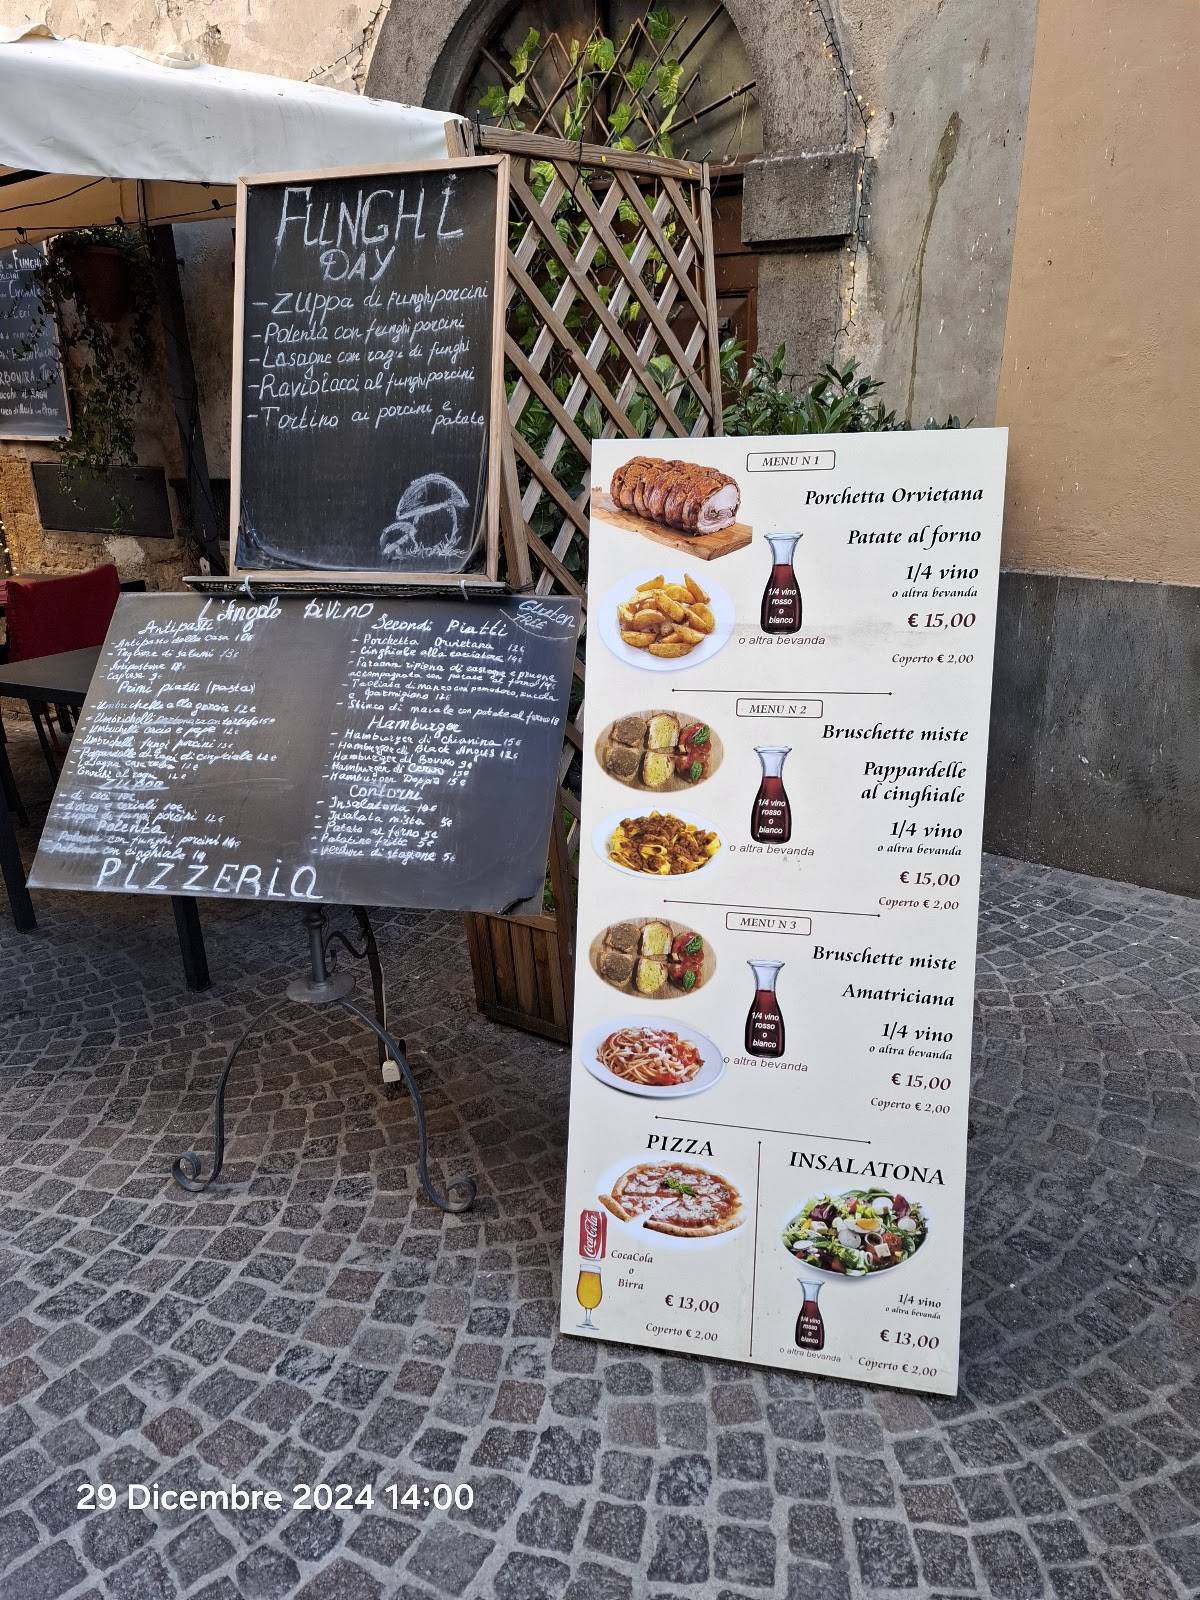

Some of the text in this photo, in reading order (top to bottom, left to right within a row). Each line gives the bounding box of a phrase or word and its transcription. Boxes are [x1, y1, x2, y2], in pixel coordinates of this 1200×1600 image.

[320, 246, 395, 281] DAY
[363, 285, 382, 307] di
[265, 323, 328, 343] Polenta
[334, 325, 362, 340] con
[337, 351, 360, 363] con
[409, 344, 422, 358] di
[428, 336, 470, 365] funghi
[364, 378, 382, 392] al
[261, 406, 338, 429] Tortino
[351, 407, 369, 422] ai
[375, 399, 432, 429] porcini
[431, 410, 484, 434] patate
[762, 455, 820, 467] MENU N 1
[804, 486, 983, 505] Porchetta Orvietana
[847, 525, 981, 550] Patate al forno
[905, 563, 978, 583] 1/4 vino
[768, 587, 797, 596] 1/4 vino
[901, 587, 928, 598] altra
[932, 586, 977, 597] bevanda
[769, 616, 793, 624] bianco
[907, 613, 976, 629] € 15,00
[738, 636, 826, 645] o altra bevanda
[891, 654, 974, 667] Coperto € 2,00
[749, 704, 807, 714] MENU N 2
[822, 723, 969, 742] Bruschette miste
[863, 761, 966, 783] Pappardelle
[758, 799, 769, 807] 1/4
[861, 783, 965, 808] al cinghiale
[759, 826, 783, 834] bianco
[889, 819, 963, 839] 1/4 vino
[739, 844, 763, 854] altra
[766, 844, 815, 856] bevanda
[887, 843, 914, 854] altra
[917, 844, 962, 856] bevanda
[899, 871, 960, 887] € 15,00
[878, 896, 959, 910] Coperto € 2,00
[740, 917, 797, 930] MENU N 3
[813, 945, 956, 970] Bruschette miste
[842, 984, 955, 1007] Amatriciana
[751, 1012, 779, 1021] 1/4 vino
[755, 1022, 775, 1030] rosso
[881, 1022, 953, 1043] 1/4 vino
[753, 1039, 777, 1048] bianco
[878, 1044, 904, 1056] altra
[908, 1046, 953, 1060] bevanda
[723, 1056, 808, 1072] o altra bevanda
[891, 1073, 951, 1091] € 15,00
[870, 1098, 950, 1114] Coperto € 2,00
[646, 1134, 714, 1157] PIZZA
[789, 1150, 945, 1185] INSALATONA
[611, 1250, 653, 1264] CocaCola
[618, 1279, 644, 1290] Birra
[665, 1294, 719, 1313] € 13,00
[898, 1293, 942, 1308] 1/4 vino
[892, 1306, 910, 1315] altra
[911, 1308, 941, 1320] bevanda
[646, 1322, 683, 1337] Coperto
[685, 1329, 692, 1338] €
[879, 1329, 940, 1350] € 13,00
[787, 1347, 805, 1358] altra
[806, 1350, 841, 1363] bevanda
[858, 1357, 937, 1377] Coperto € 2,00
